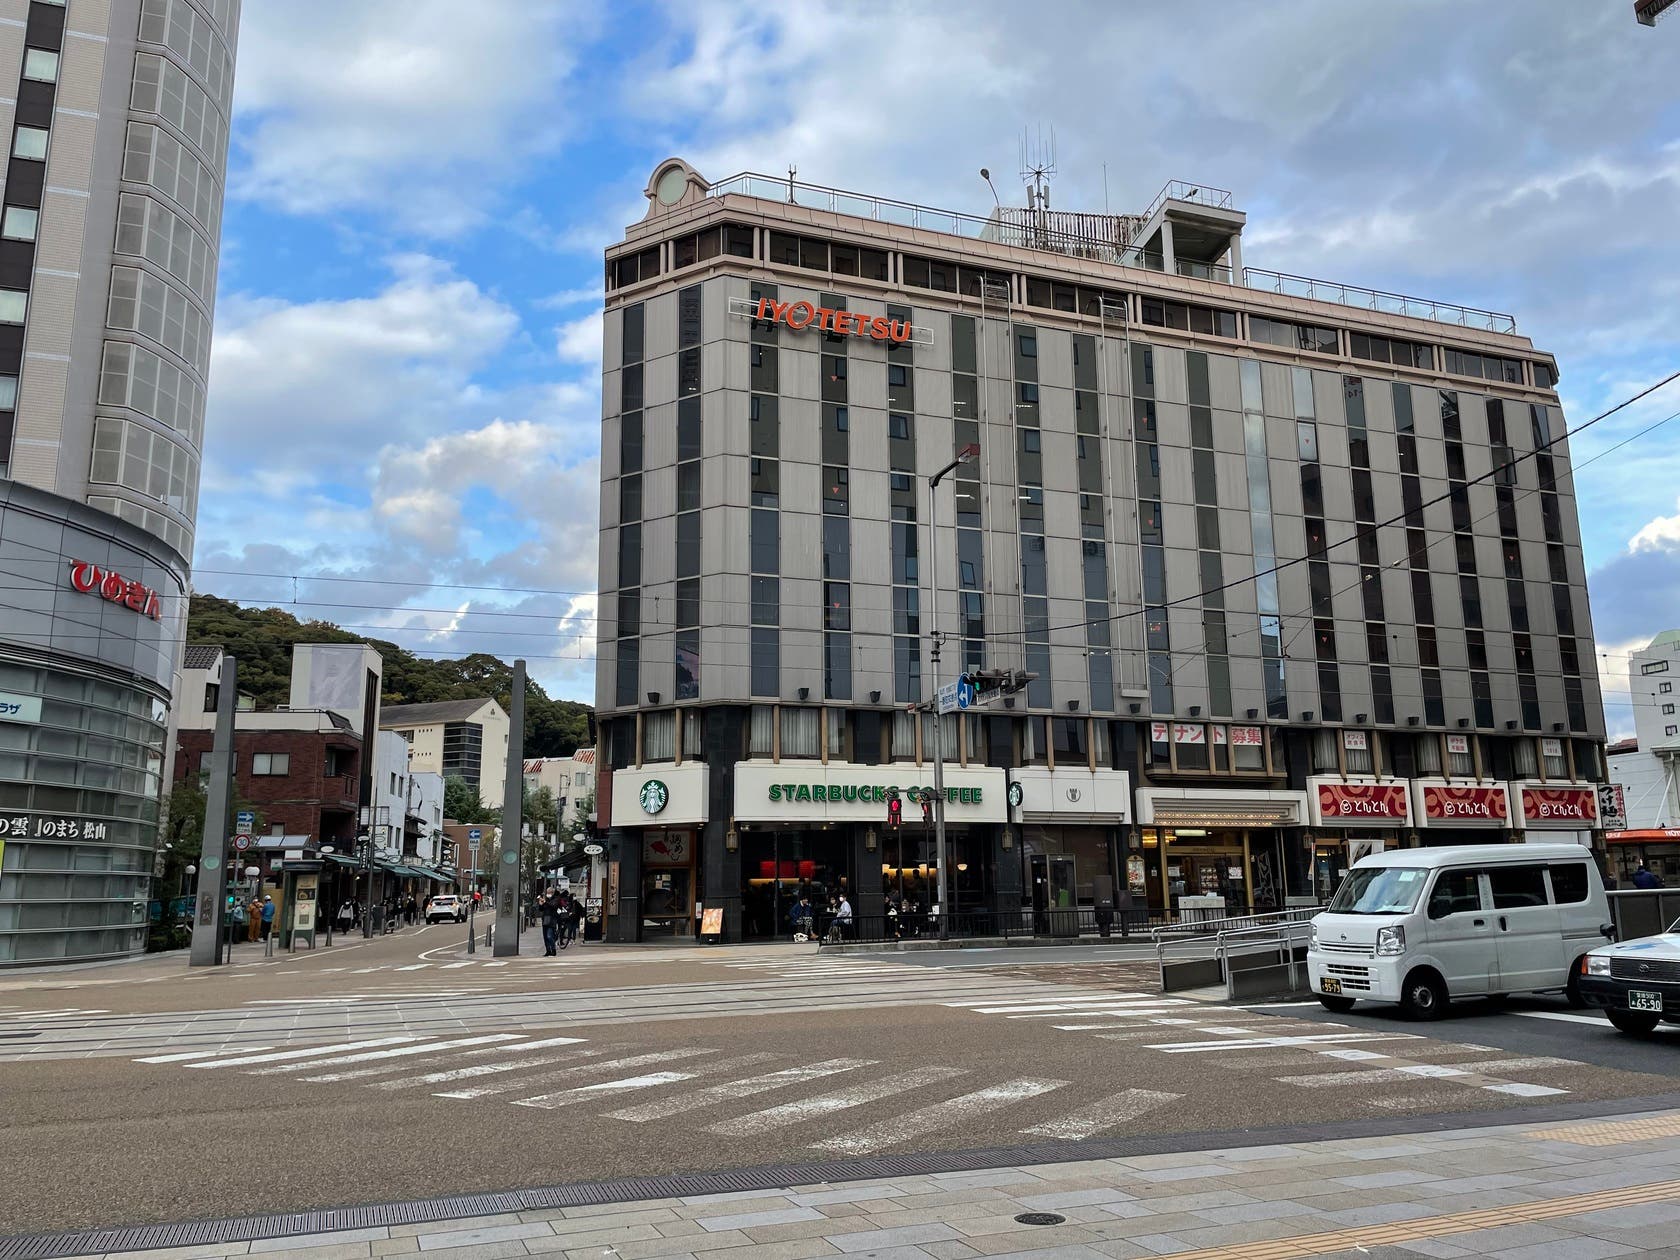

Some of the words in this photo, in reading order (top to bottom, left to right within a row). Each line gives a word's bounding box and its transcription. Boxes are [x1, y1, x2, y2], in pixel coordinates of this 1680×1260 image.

[756, 297, 911, 342] IYOTETSU
[70, 559, 160, 621] ひめぎん
[769, 784, 899, 803] STARBUCKS
[1354, 800, 1389, 813] とんとん
[1457, 802, 1490, 815] とんとん
[1552, 804, 1582, 816] とんとん
[83, 821, 106, 840] 松山
[1637, 998, 1661, 1010] 65-90
